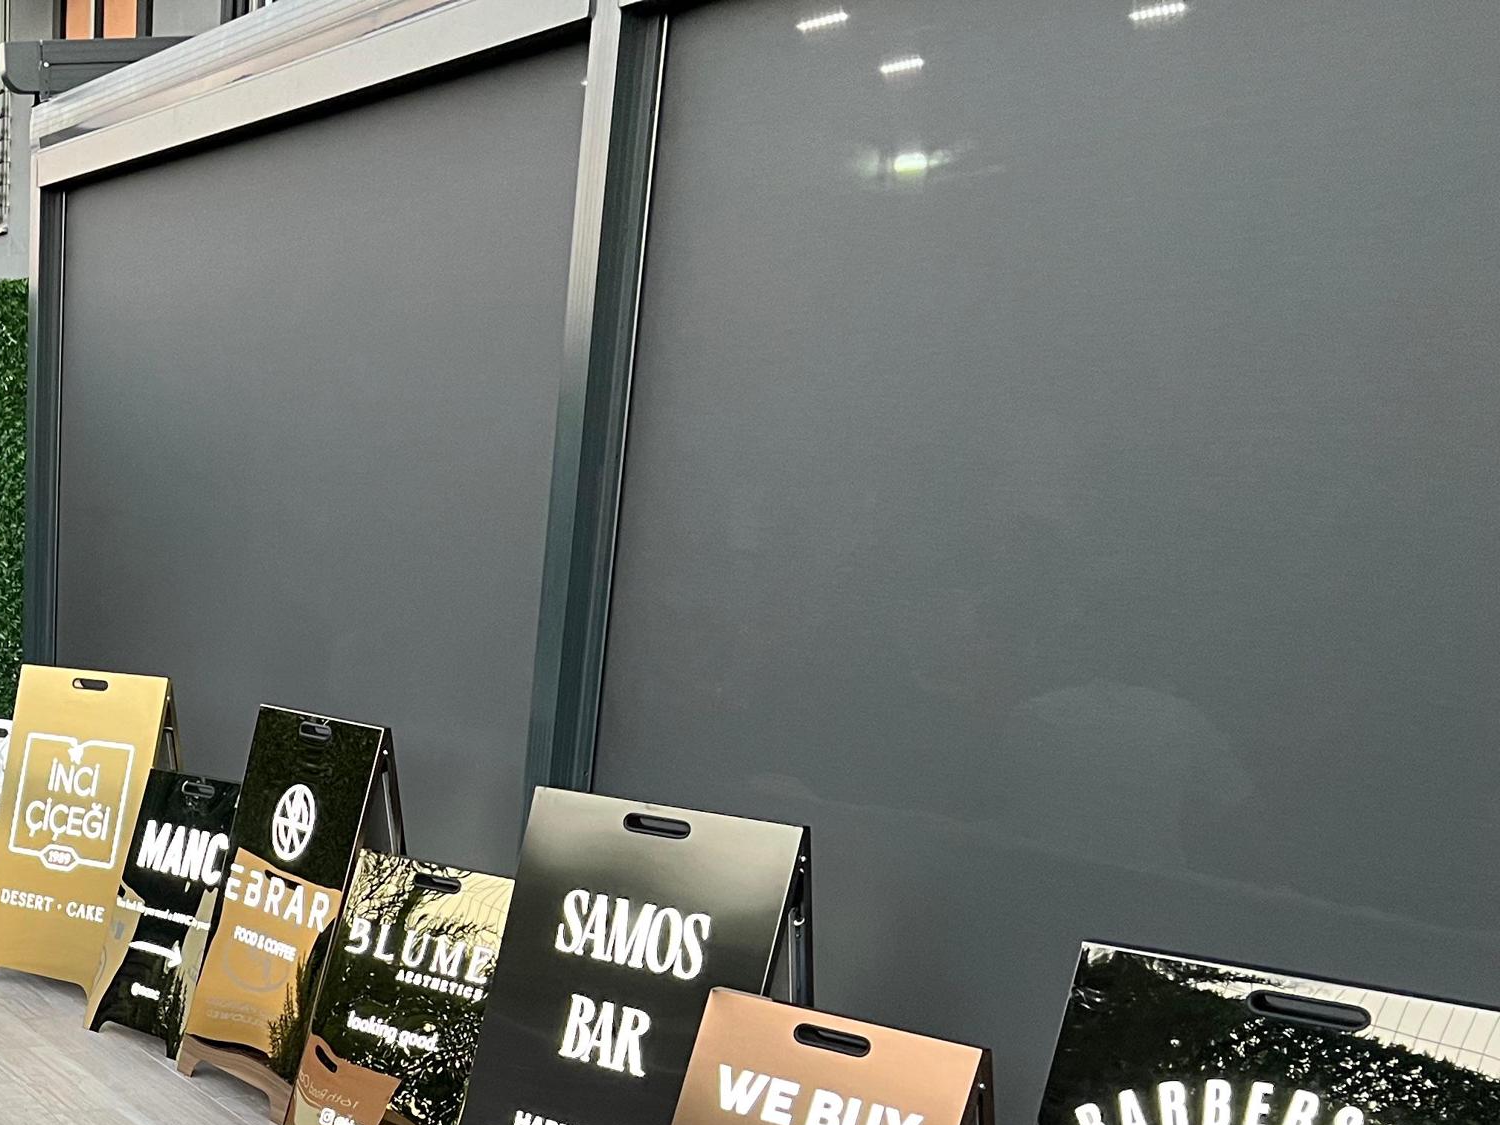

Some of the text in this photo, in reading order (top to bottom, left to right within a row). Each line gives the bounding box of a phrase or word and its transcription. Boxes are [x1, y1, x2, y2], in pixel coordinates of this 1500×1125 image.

[25, 797, 111, 842] ÇİÇEĞİ
[0, 888, 54, 913] DESERT
[65, 902, 105, 923] CAKE
[224, 863, 330, 933] EBRAR
[233, 925, 257, 947] FOOD
[264, 938, 298, 963] COFFEE
[345, 917, 494, 985] BLUME
[555, 889, 711, 981] SAMOS
[347, 1009, 399, 1045] looking
[558, 993, 651, 1078] BAR
